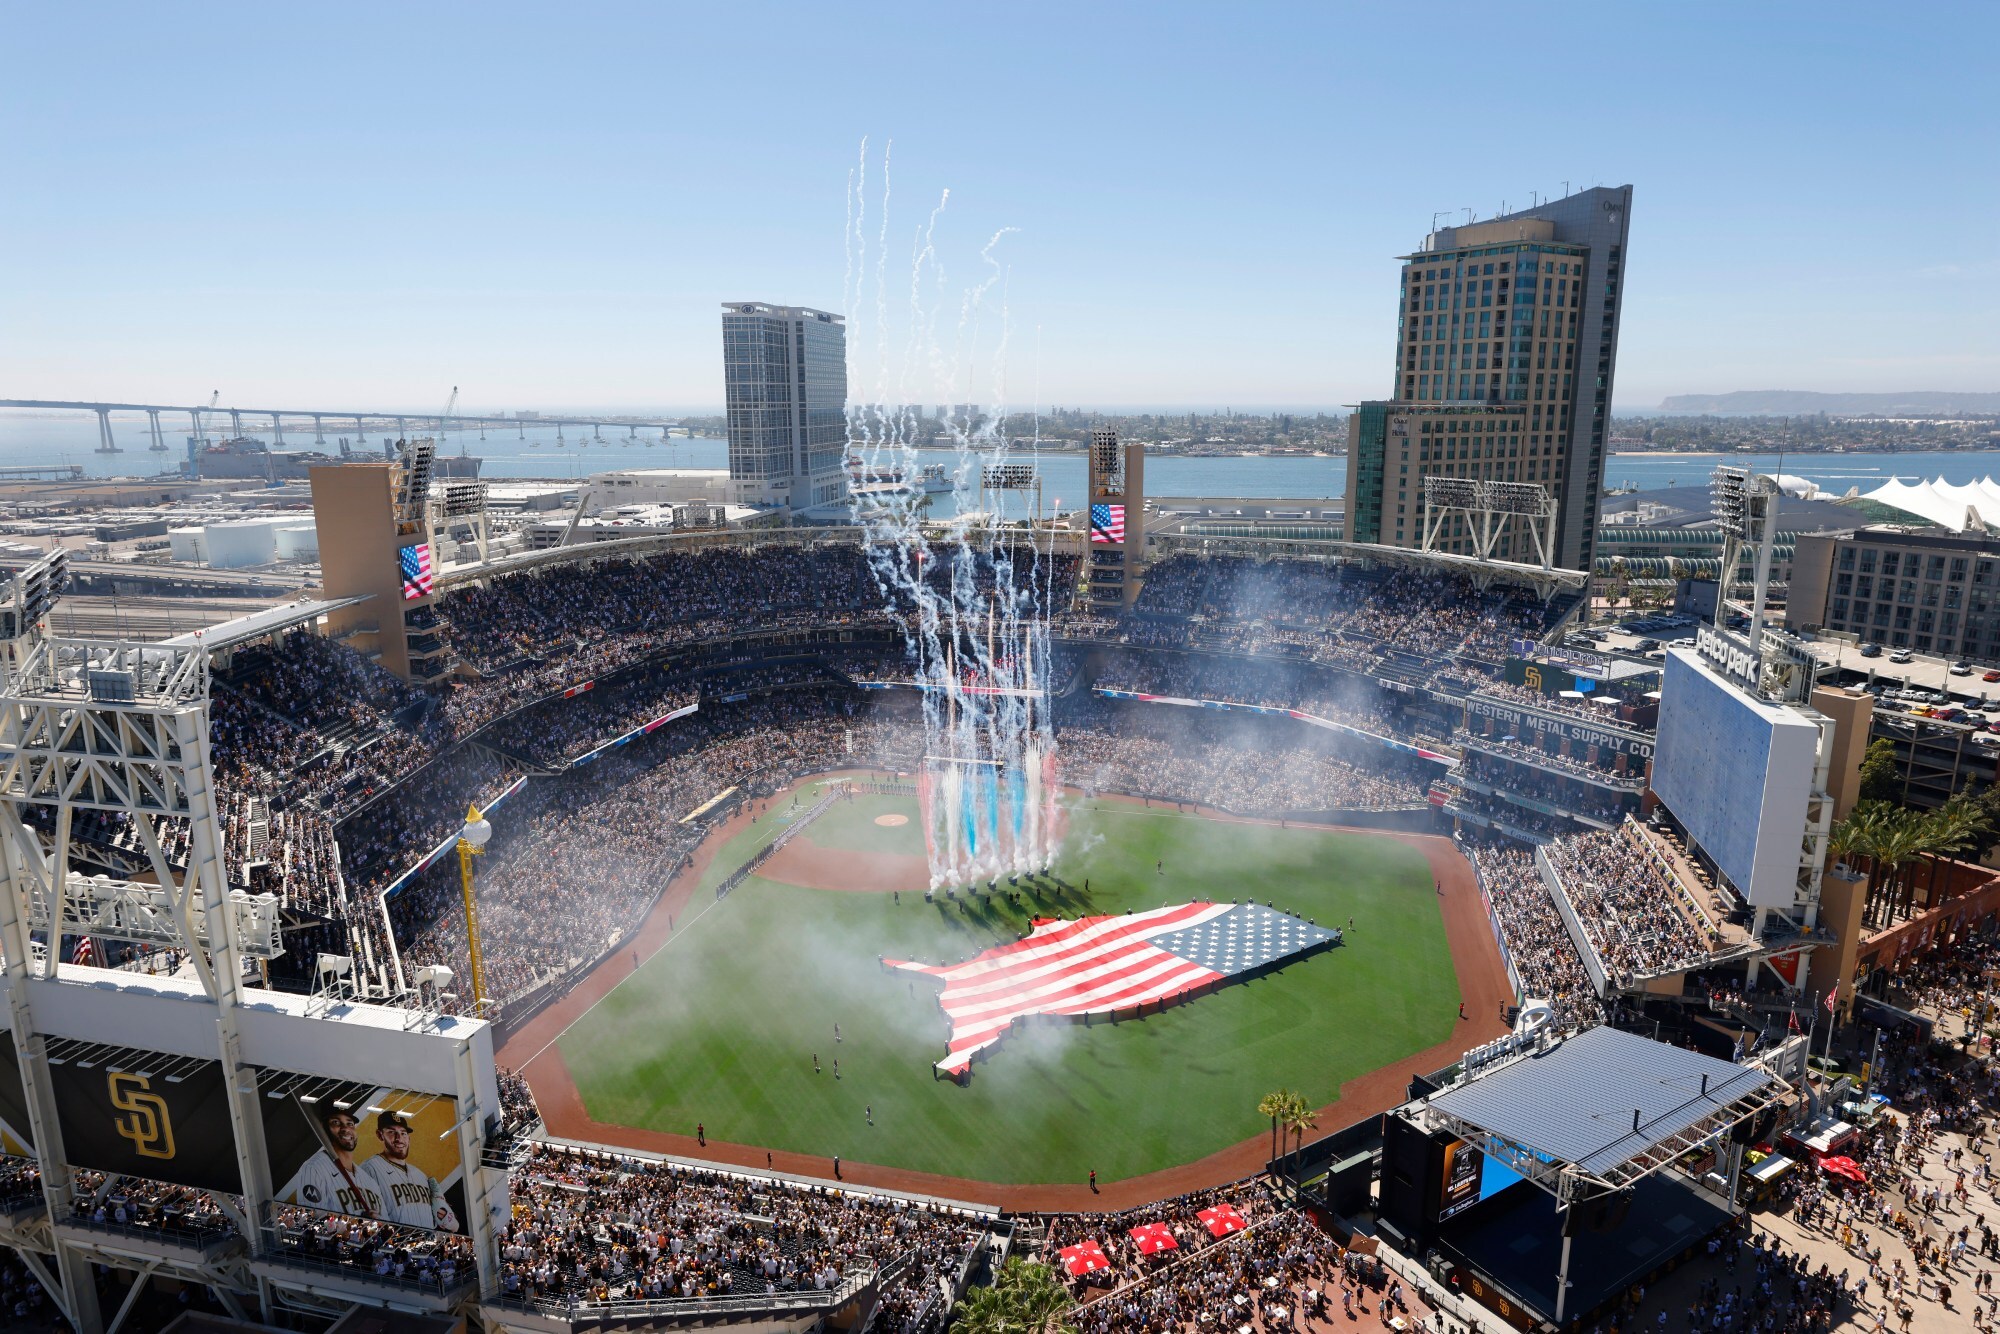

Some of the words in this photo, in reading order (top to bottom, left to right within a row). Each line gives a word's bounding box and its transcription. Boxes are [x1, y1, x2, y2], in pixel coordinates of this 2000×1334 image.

[1696, 627, 1729, 664] petco
[1726, 646, 1759, 683] park
[1466, 701, 1520, 724] WESTERN
[1526, 716, 1567, 737] METAL
[1571, 727, 1624, 750] SUPPLY
[107, 1071, 176, 1160] SD
